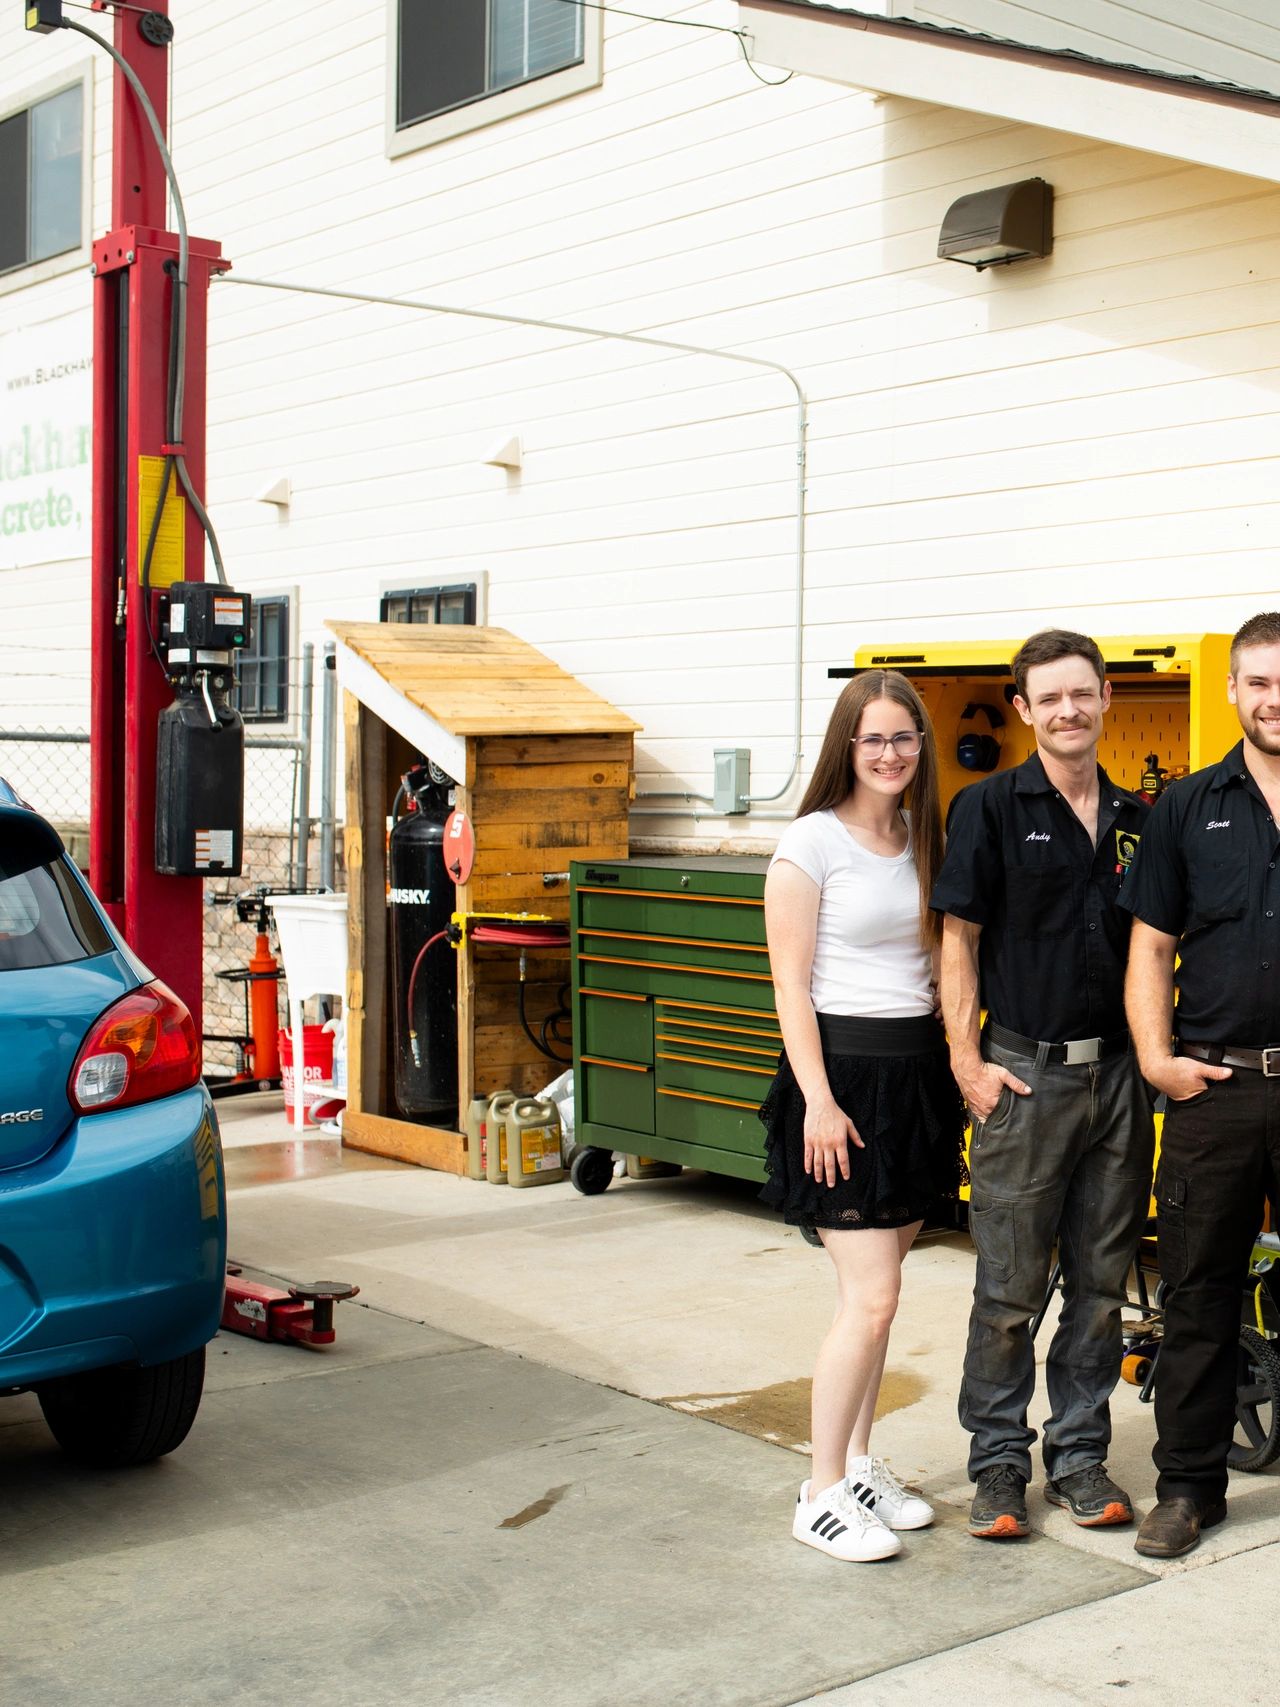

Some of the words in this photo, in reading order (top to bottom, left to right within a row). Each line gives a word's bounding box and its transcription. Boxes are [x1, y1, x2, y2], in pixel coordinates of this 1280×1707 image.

[0, 487, 82, 536] crete,
[1205, 820, 1231, 831] Scott
[1025, 831, 1051, 842] Andy
